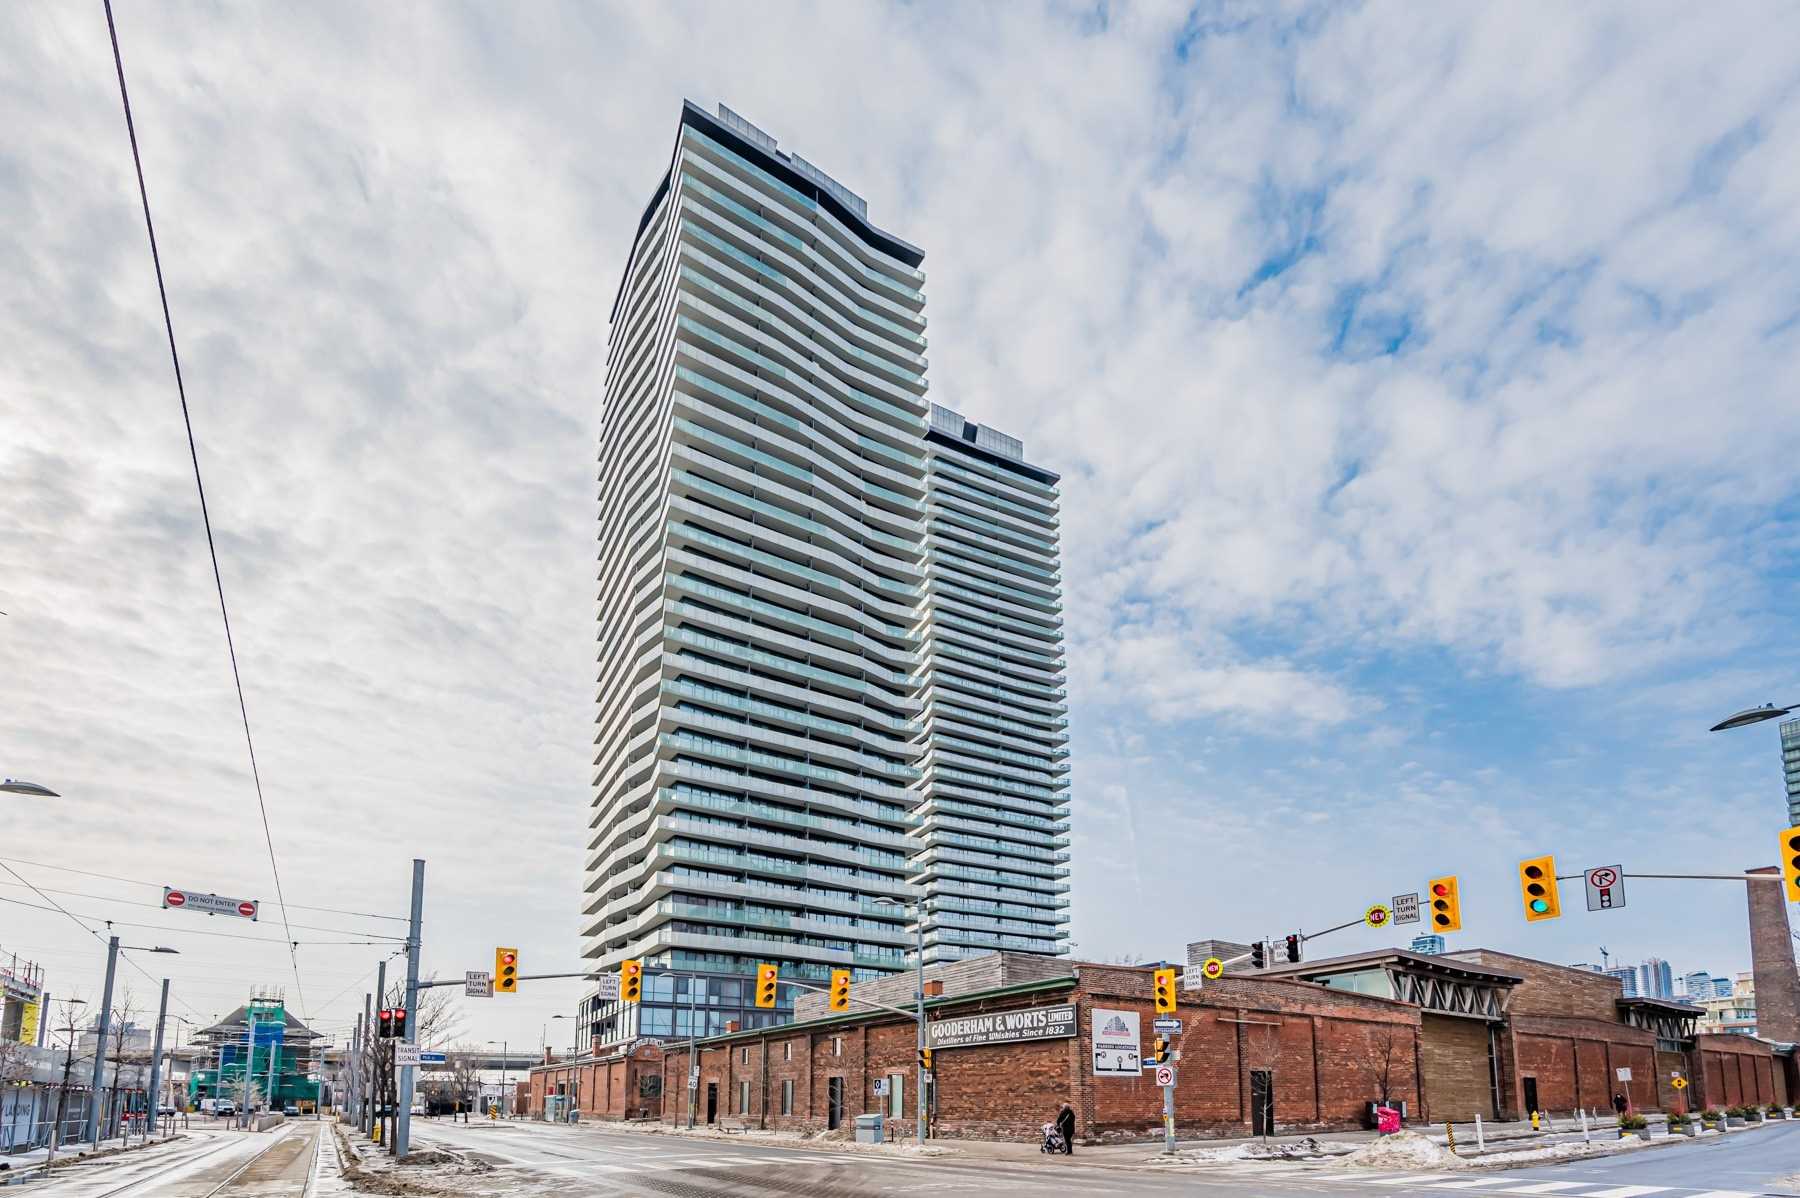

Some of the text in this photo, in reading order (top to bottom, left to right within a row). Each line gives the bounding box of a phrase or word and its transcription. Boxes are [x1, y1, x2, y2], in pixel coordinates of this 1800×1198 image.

[188, 895, 236, 908] DO NOT ENTER
[1396, 897, 1414, 906] LEFT
[1397, 904, 1416, 913] TURN
[1370, 912, 1385, 921] NEW
[1395, 913, 1418, 921] SIGNAL
[1207, 964, 1219, 972] NEW
[931, 1010, 1073, 1038] GOODERHAM & WORTS LIMITED
[937, 1033, 964, 1045] Distillers
[965, 1034, 973, 1042] of
[988, 1030, 1020, 1040] Whiskies
[1022, 1028, 1043, 1037] Since
[1045, 1025, 1065, 1035] 1832
